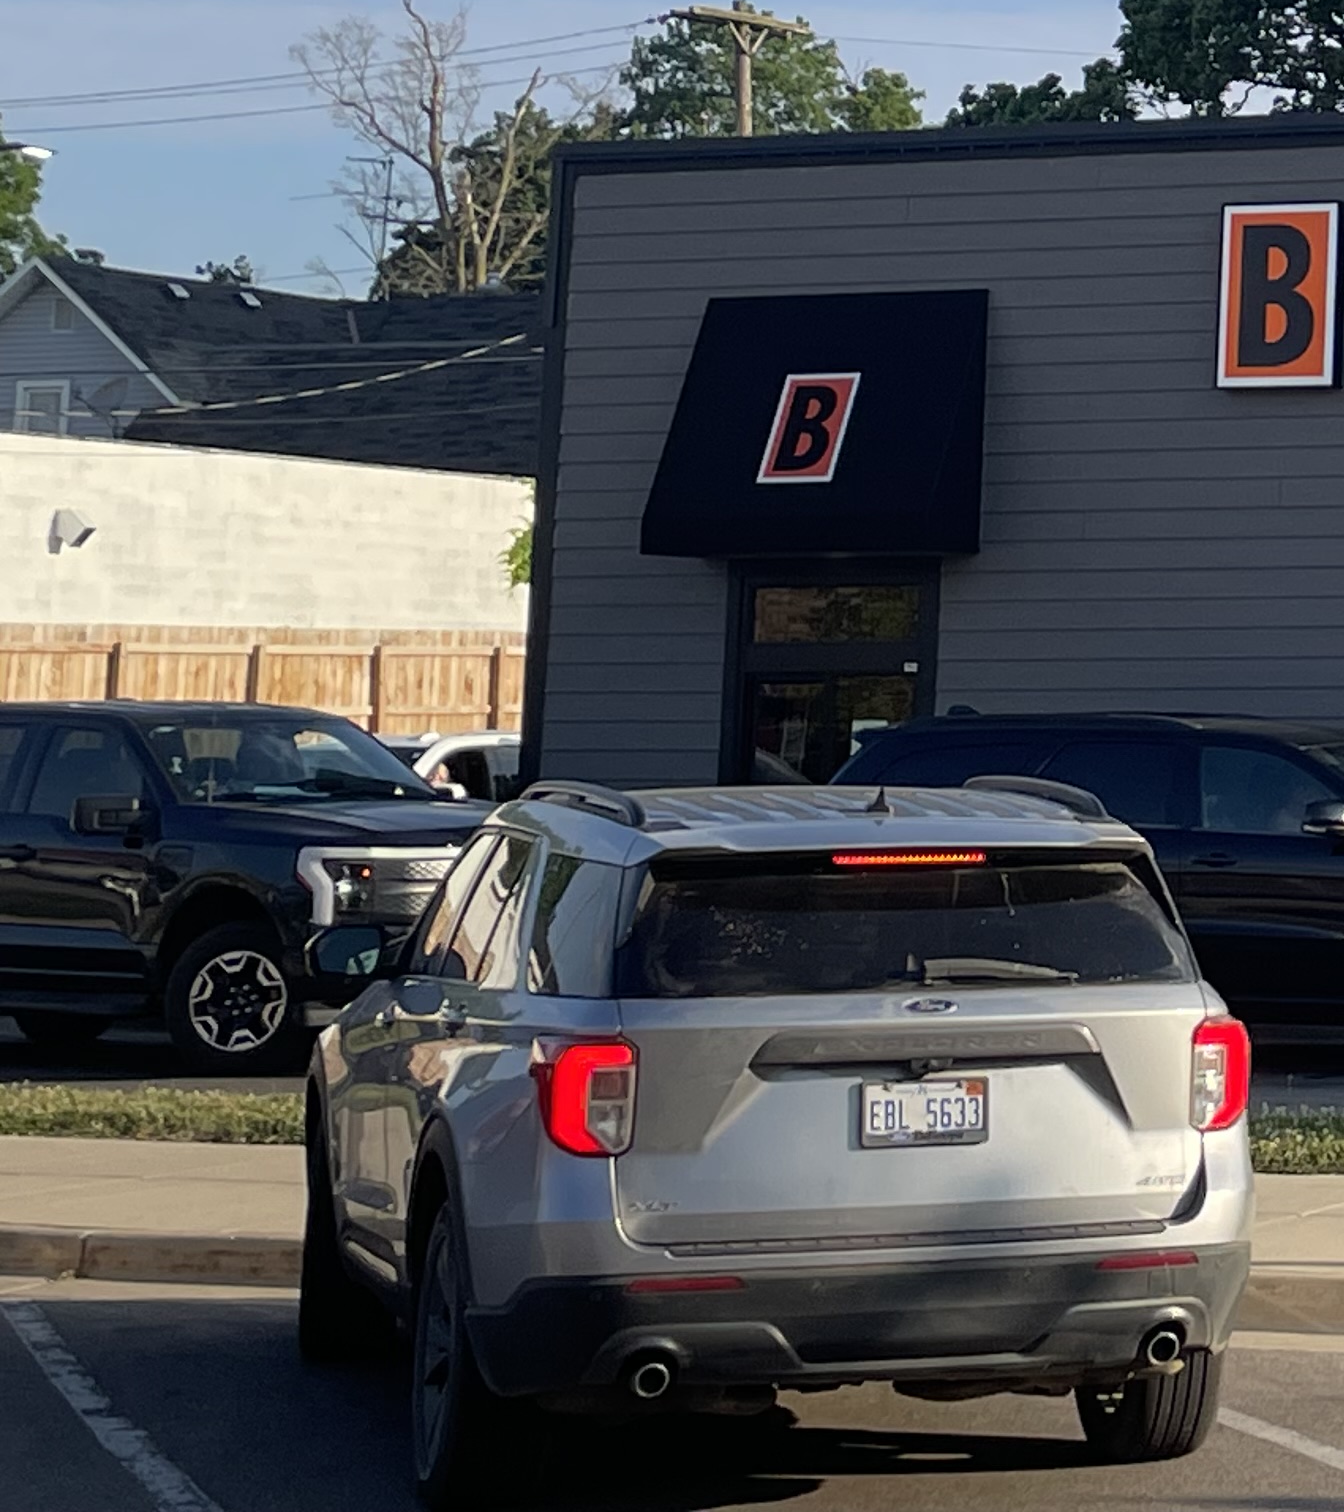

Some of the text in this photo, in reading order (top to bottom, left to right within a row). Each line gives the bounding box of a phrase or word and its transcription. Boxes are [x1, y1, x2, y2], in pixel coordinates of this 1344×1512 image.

[1237, 224, 1314, 368] B
[772, 385, 838, 471] B
[871, 1098, 979, 1130] EBL 5633
